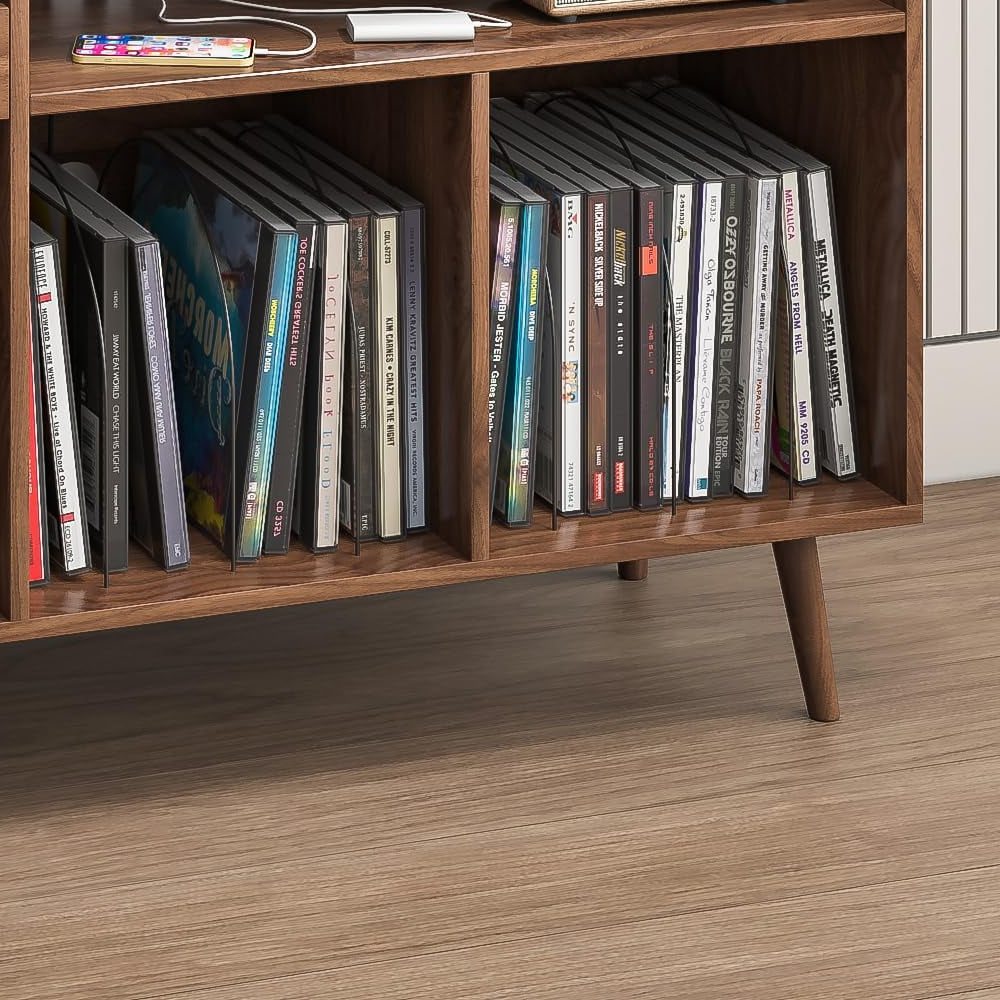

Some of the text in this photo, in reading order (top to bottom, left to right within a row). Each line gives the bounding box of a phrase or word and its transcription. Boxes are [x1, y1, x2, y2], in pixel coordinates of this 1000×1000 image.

[594, 203, 604, 307] NICKELBACK SILVER SIDE UP
[761, 244, 769, 272] GETTING
[704, 258, 716, 286] Olga
[760, 273, 768, 291] AWAY
[408, 280, 416, 310] LENNY
[497, 281, 509, 322] MORBID
[675, 295, 684, 315] THE
[720, 258, 737, 344] OSBOURNE
[41, 307, 50, 342] HOWARD
[357, 325, 366, 347] JUDAS
[409, 313, 417, 352] KRAVITZ
[784, 189, 810, 464] METALLICA ANGELS FROM HELL MM 9205 CD
[814, 238, 842, 408] METALLICA DEATH MAGNETIC
[493, 324, 505, 362] JESTER
[46, 351, 54, 365] THE
[358, 348, 367, 373] PRIEST
[718, 348, 733, 395] BLACK
[47, 366, 56, 390] WHITE
[385, 317, 395, 447] KIM CARNES CRAZY IN THE NIGHT
[410, 354, 418, 398] GREATEST
[50, 391, 58, 412] BOYS
[755, 378, 763, 402] PAPA
[359, 379, 368, 430] NOSTRADAMUS
[717, 399, 731, 434] RAIN
[53, 422, 61, 437] Live
[112, 405, 120, 432] CHASE
[753, 403, 762, 434] ROACH
[55, 439, 62, 447] at
[112, 432, 120, 449] THIS
[714, 436, 723, 469] EDITION
[721, 435, 729, 458] TOUR
[56, 450, 65, 473] Chord
[112, 450, 120, 473] LIGHT
[59, 475, 67, 486] On
[713, 470, 721, 487] EPIC
[60, 488, 68, 509] Blues
